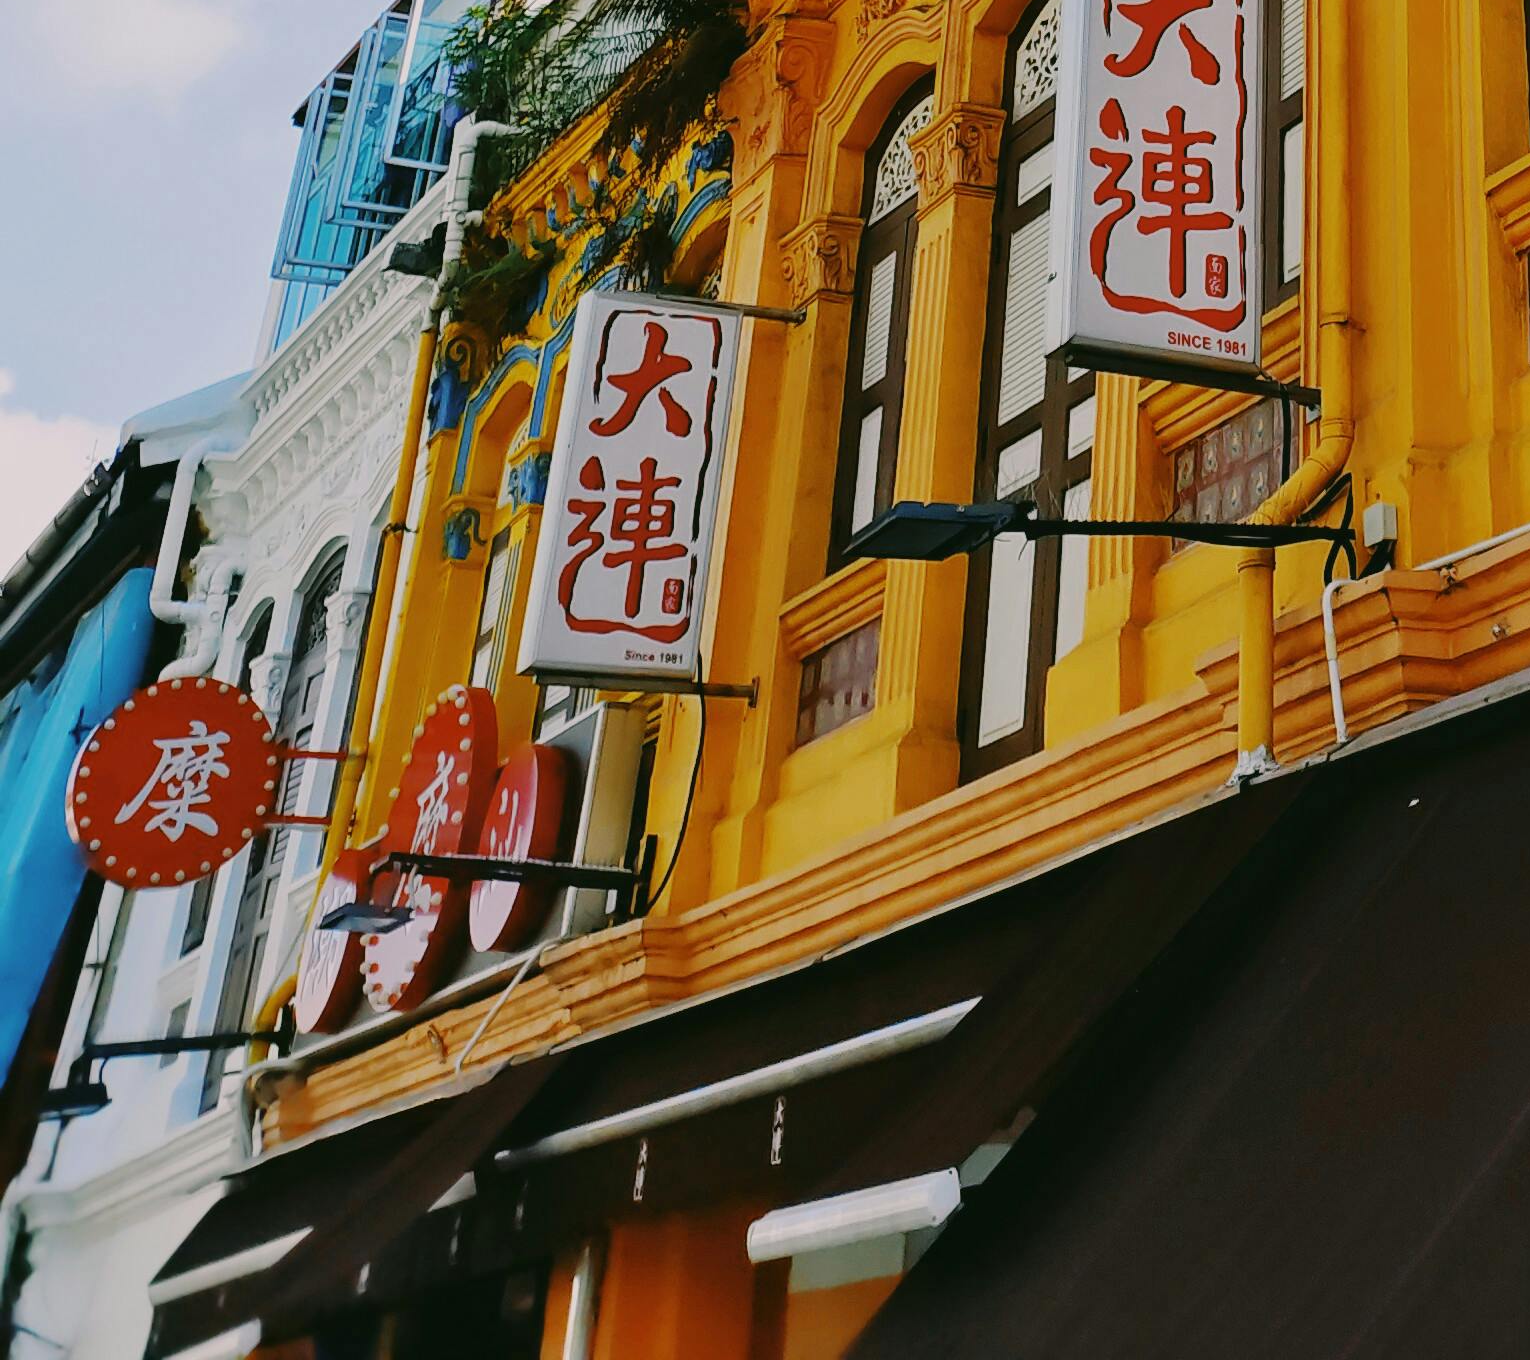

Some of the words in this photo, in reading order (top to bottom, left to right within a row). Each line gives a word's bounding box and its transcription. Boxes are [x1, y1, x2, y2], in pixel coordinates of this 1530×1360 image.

[1167, 331, 1212, 350] SINCE
[1216, 338, 1246, 356] 1981
[558, 321, 693, 644] 大連
[624, 650, 655, 662] Since
[659, 652, 683, 664] 1981
